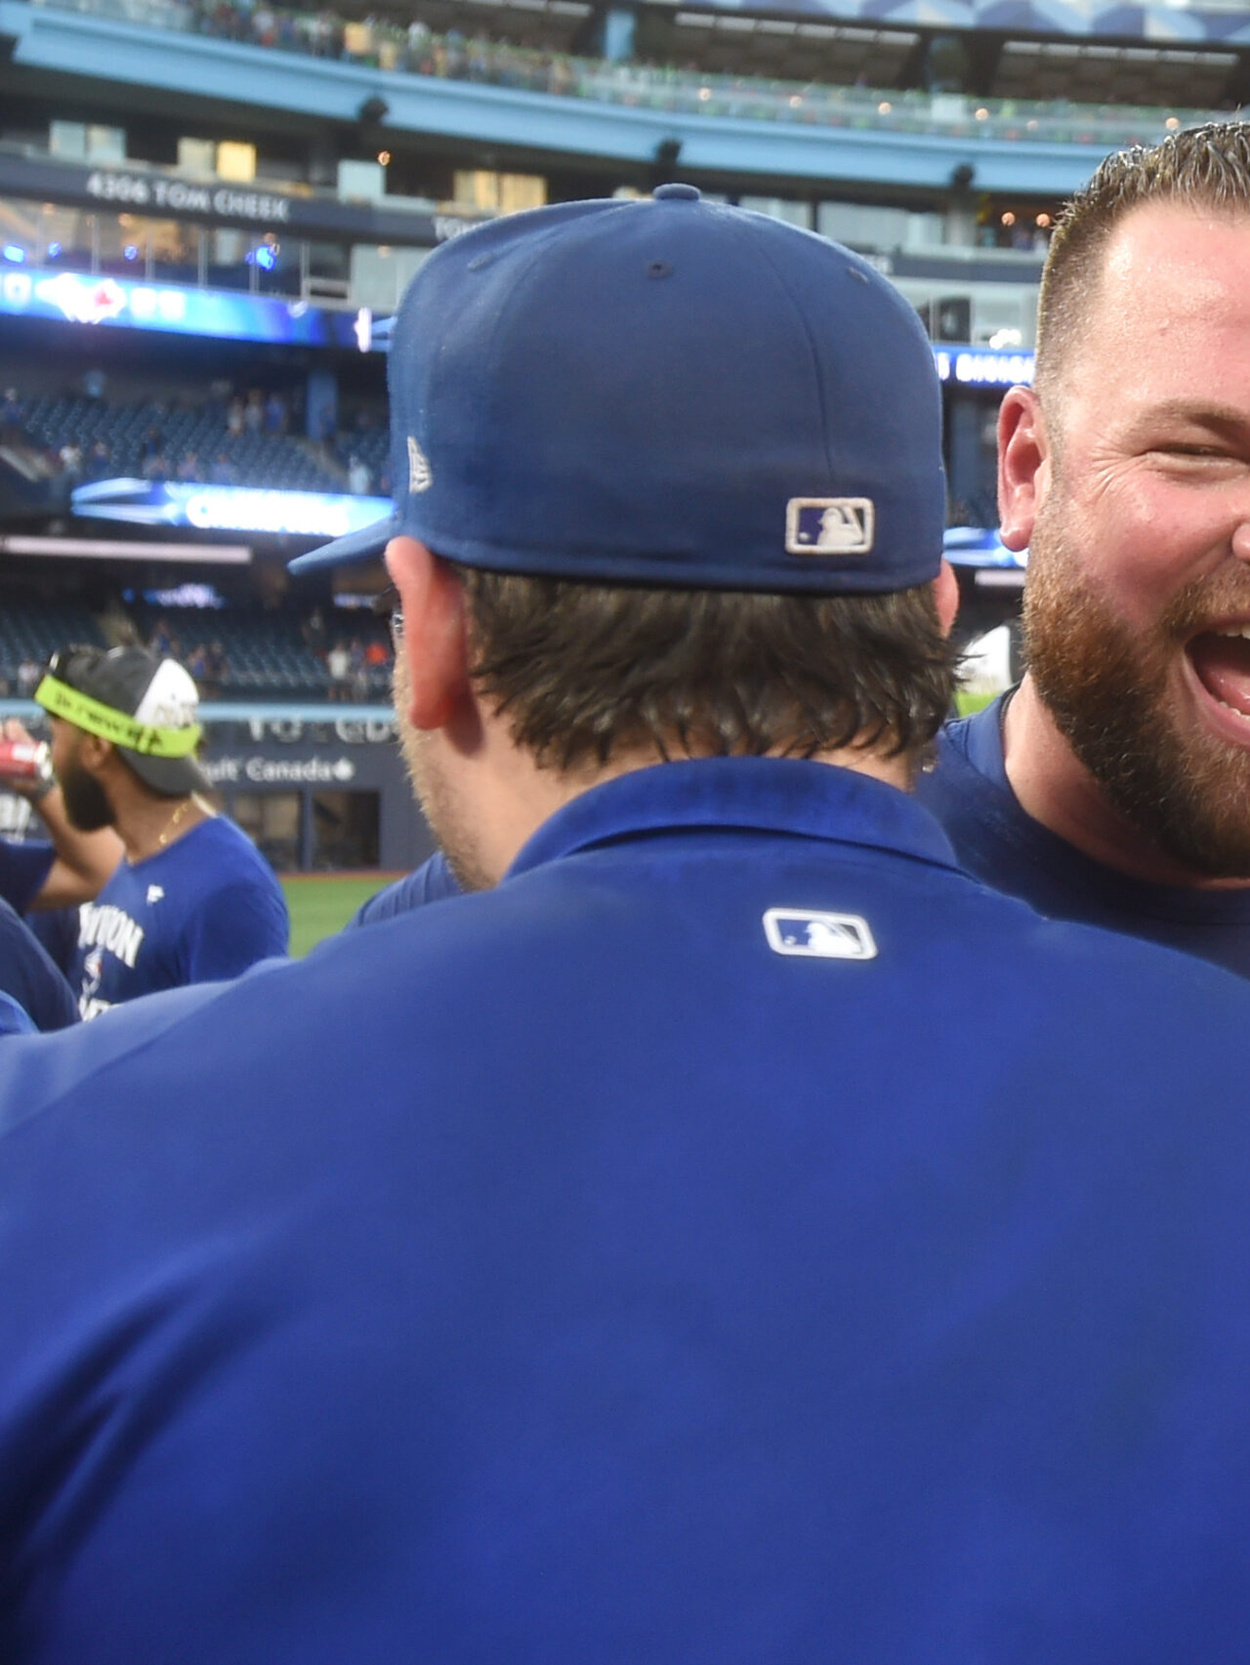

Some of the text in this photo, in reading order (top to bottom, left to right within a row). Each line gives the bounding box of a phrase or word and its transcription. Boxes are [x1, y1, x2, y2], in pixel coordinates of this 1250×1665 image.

[153, 181, 212, 213] TOM
[213, 189, 291, 224] CHEEK
[245, 756, 333, 782] Canada
